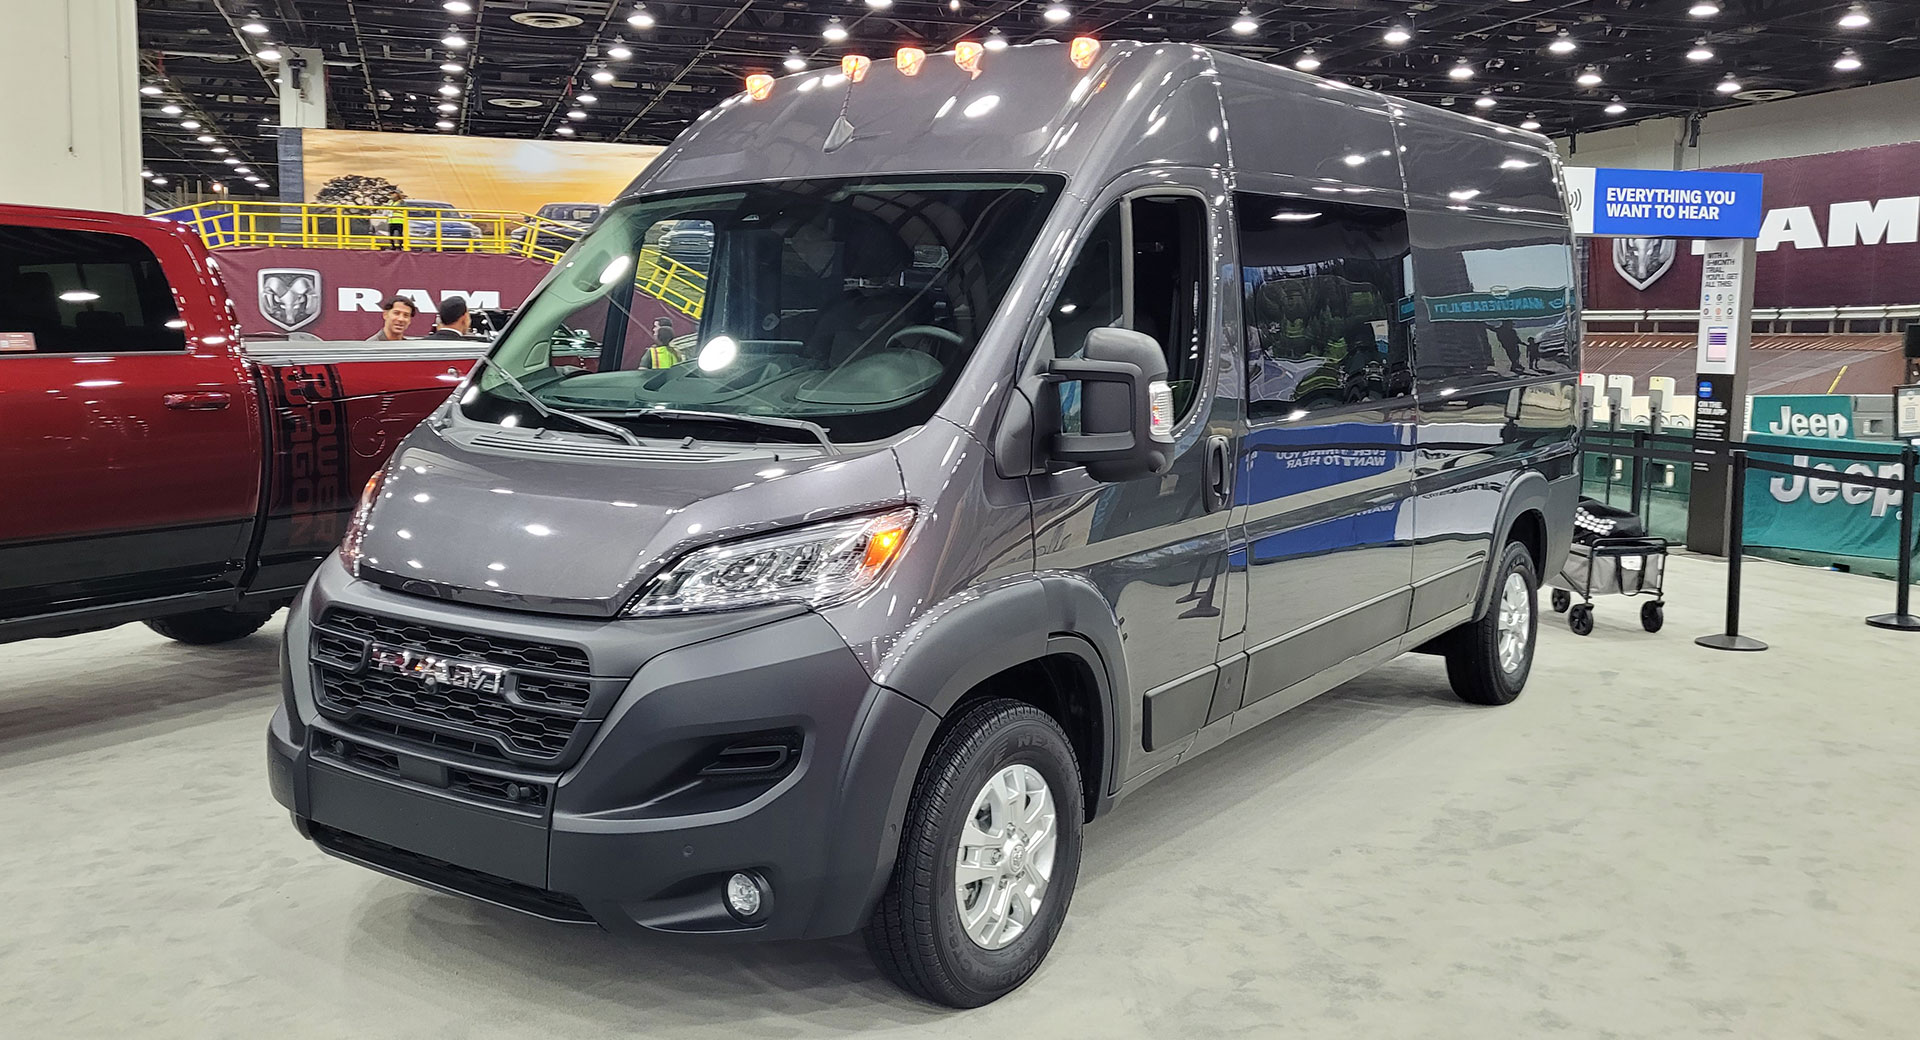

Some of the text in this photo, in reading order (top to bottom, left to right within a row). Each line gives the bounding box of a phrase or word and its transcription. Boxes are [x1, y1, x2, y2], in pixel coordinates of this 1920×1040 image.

[1606, 187, 1736, 205] EVERYTHING YOU
[1606, 203, 1720, 220] WANT TO HEAR
[338, 287, 500, 313] RAM
[1769, 405, 1848, 439] Jeep
[303, 364, 339, 541] POWER
[1769, 455, 1904, 517] Jeep
[369, 641, 503, 694] RAM
